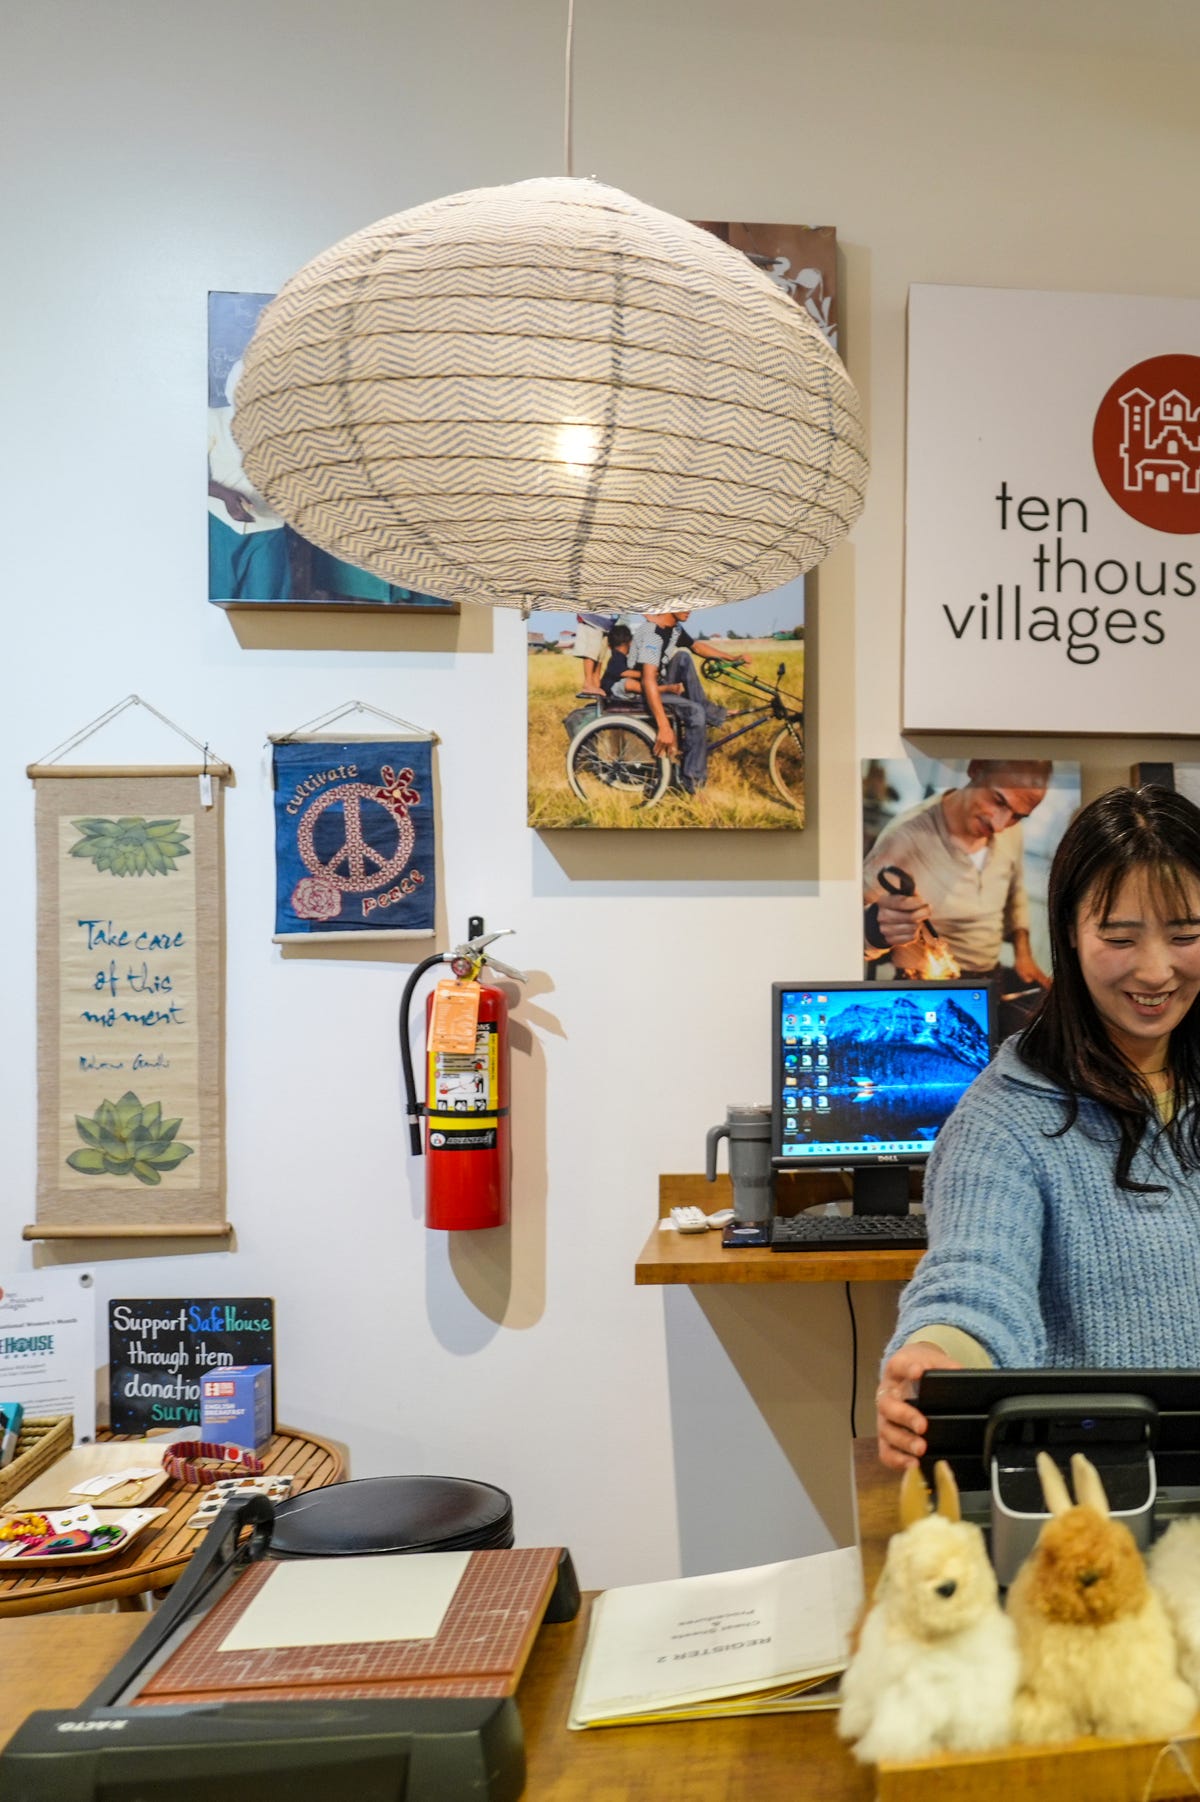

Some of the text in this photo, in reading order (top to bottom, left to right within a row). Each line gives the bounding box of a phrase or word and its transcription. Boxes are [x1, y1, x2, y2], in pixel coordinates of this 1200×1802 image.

[996, 481, 1088, 533] ten
[942, 584, 1166, 664] villages
[285, 764, 359, 815] cultivate
[362, 869, 425, 918] peace
[78, 920, 187, 951] Take care
[94, 960, 172, 997] of this
[81, 1001, 185, 1028] moment
[113, 1306, 188, 1339] Support
[127, 1341, 234, 1374] through item
[124, 1374, 200, 1400] donatio
[656, 1636, 772, 1664] REGISTER 2
